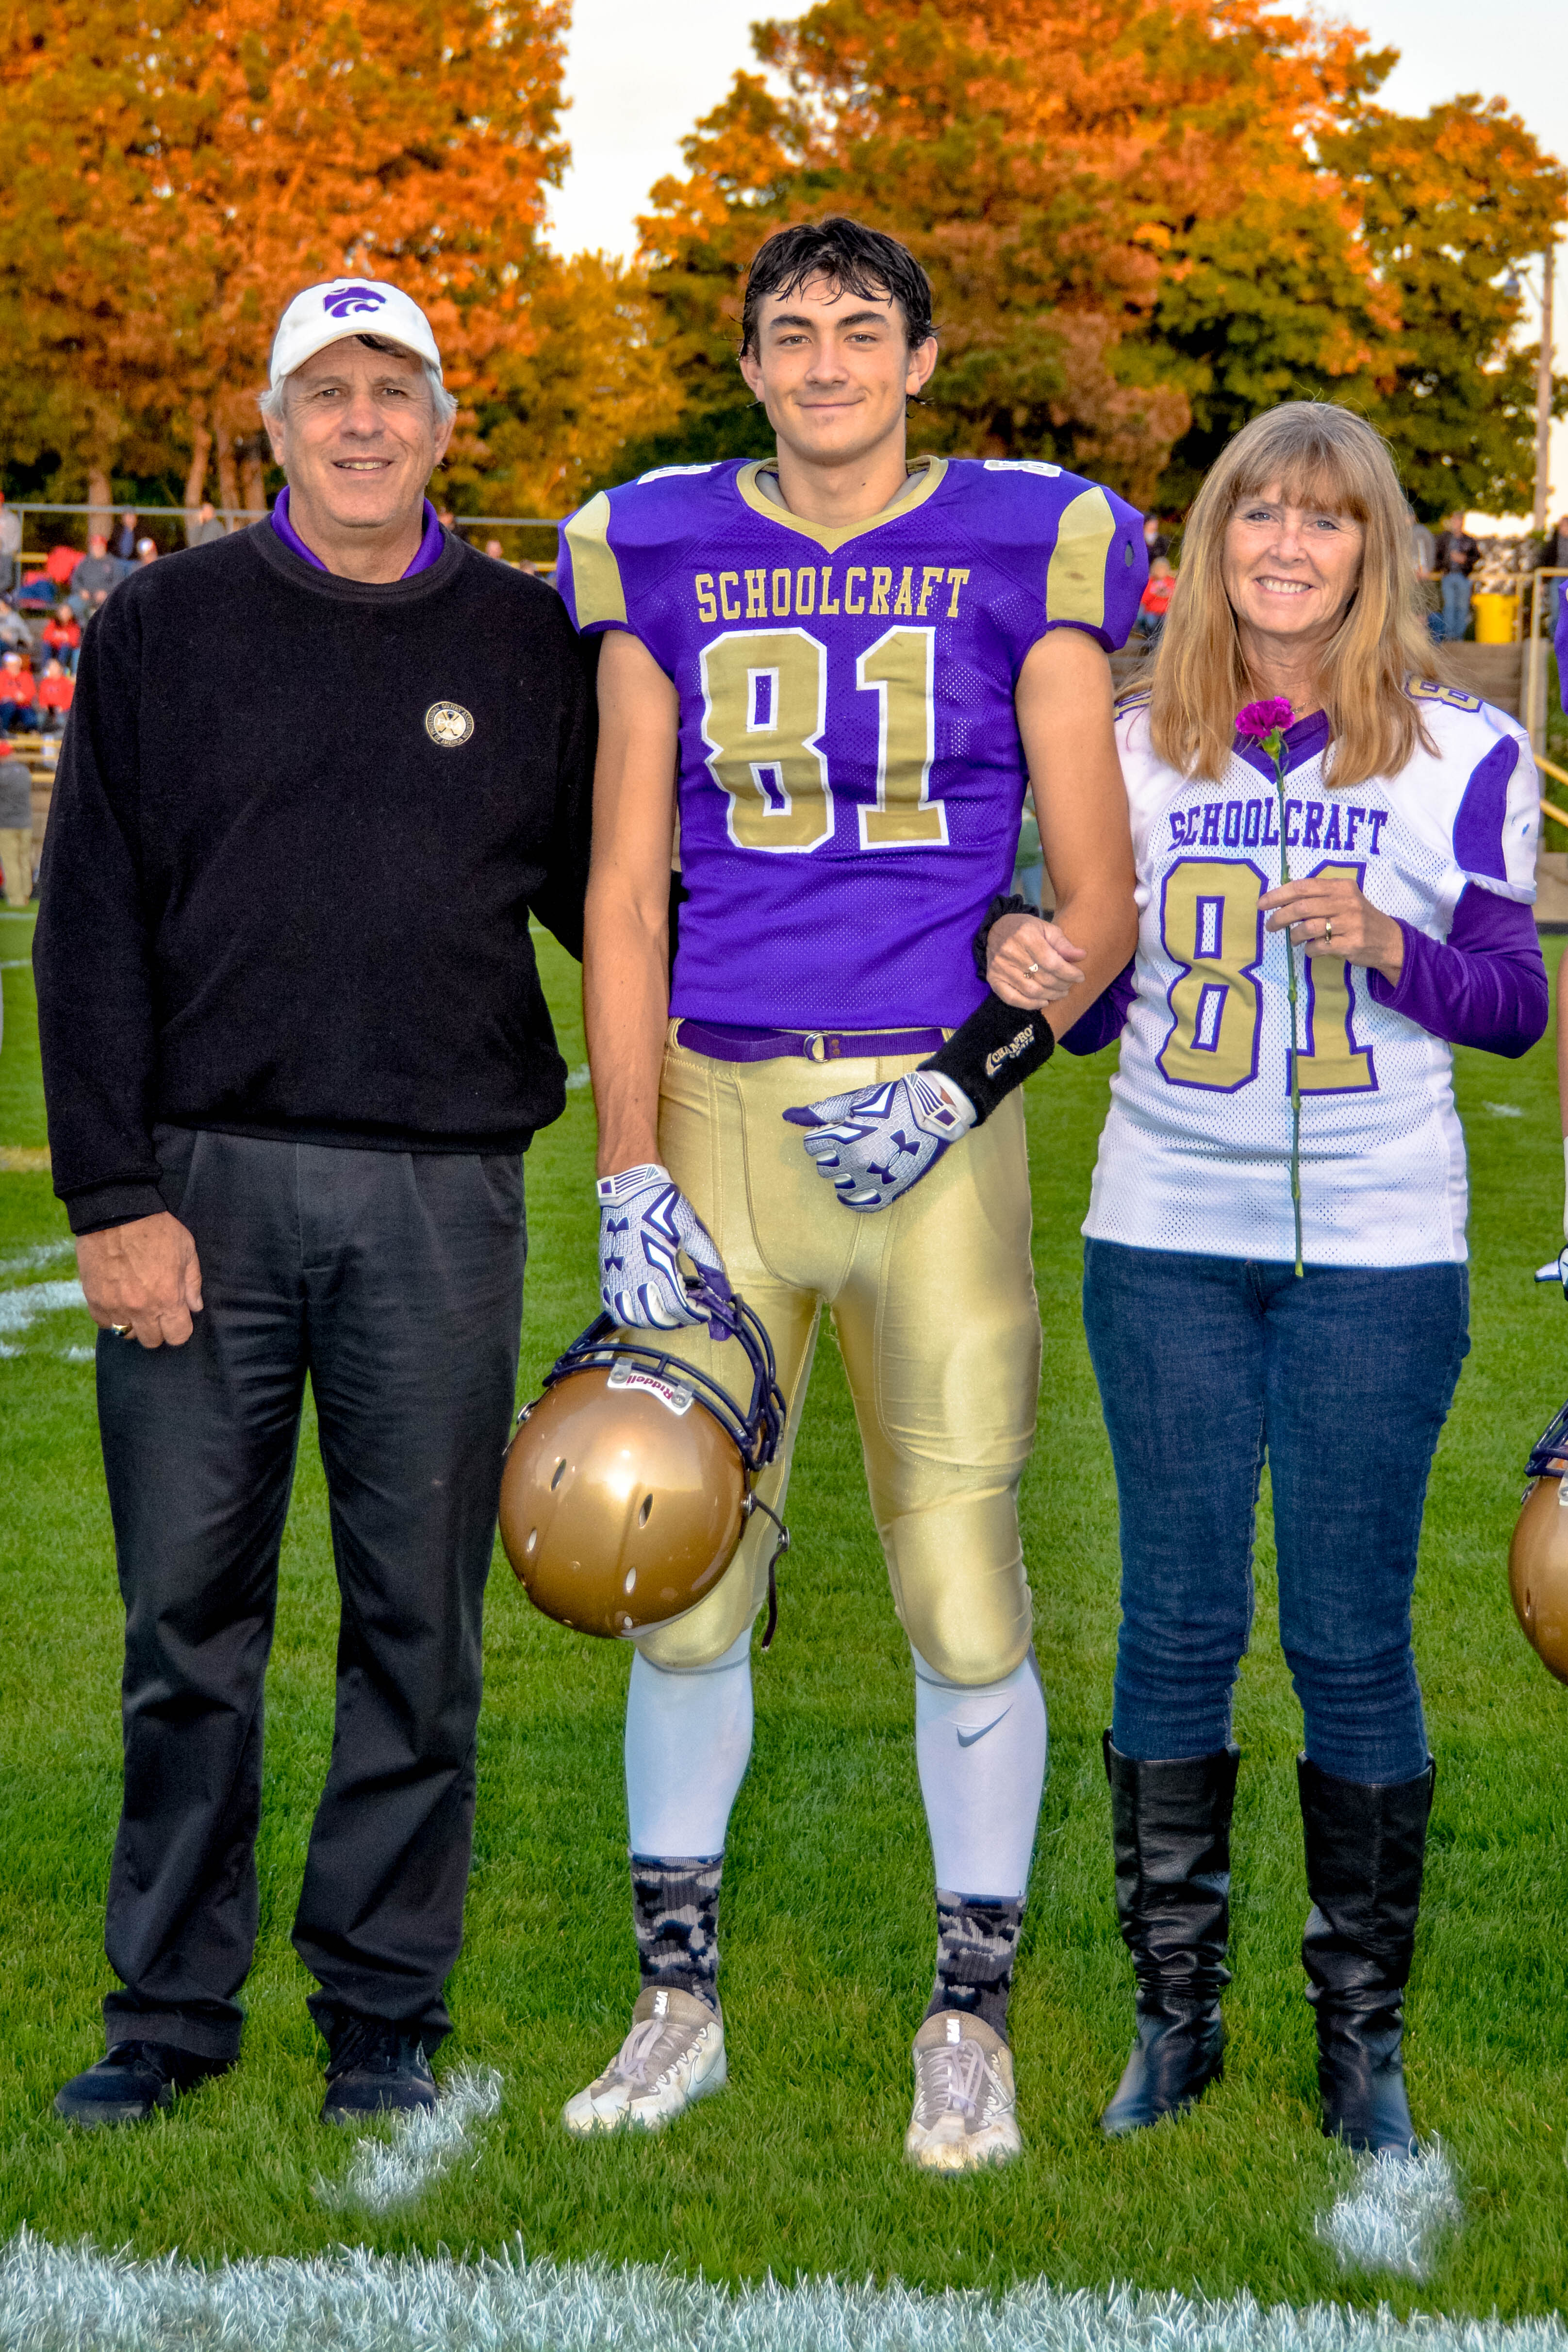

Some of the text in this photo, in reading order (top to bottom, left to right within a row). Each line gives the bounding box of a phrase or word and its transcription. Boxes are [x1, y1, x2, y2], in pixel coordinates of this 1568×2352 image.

[694, 566, 970, 623] SCHOOLCRAFT
[700, 625, 950, 854] 81
[1168, 797, 1388, 855] SCHOOLCRAFT
[1155, 856, 1379, 1096] 81
[991, 1027, 1033, 1063] CHAMPRO
[626, 1375, 674, 1400] Riddell
